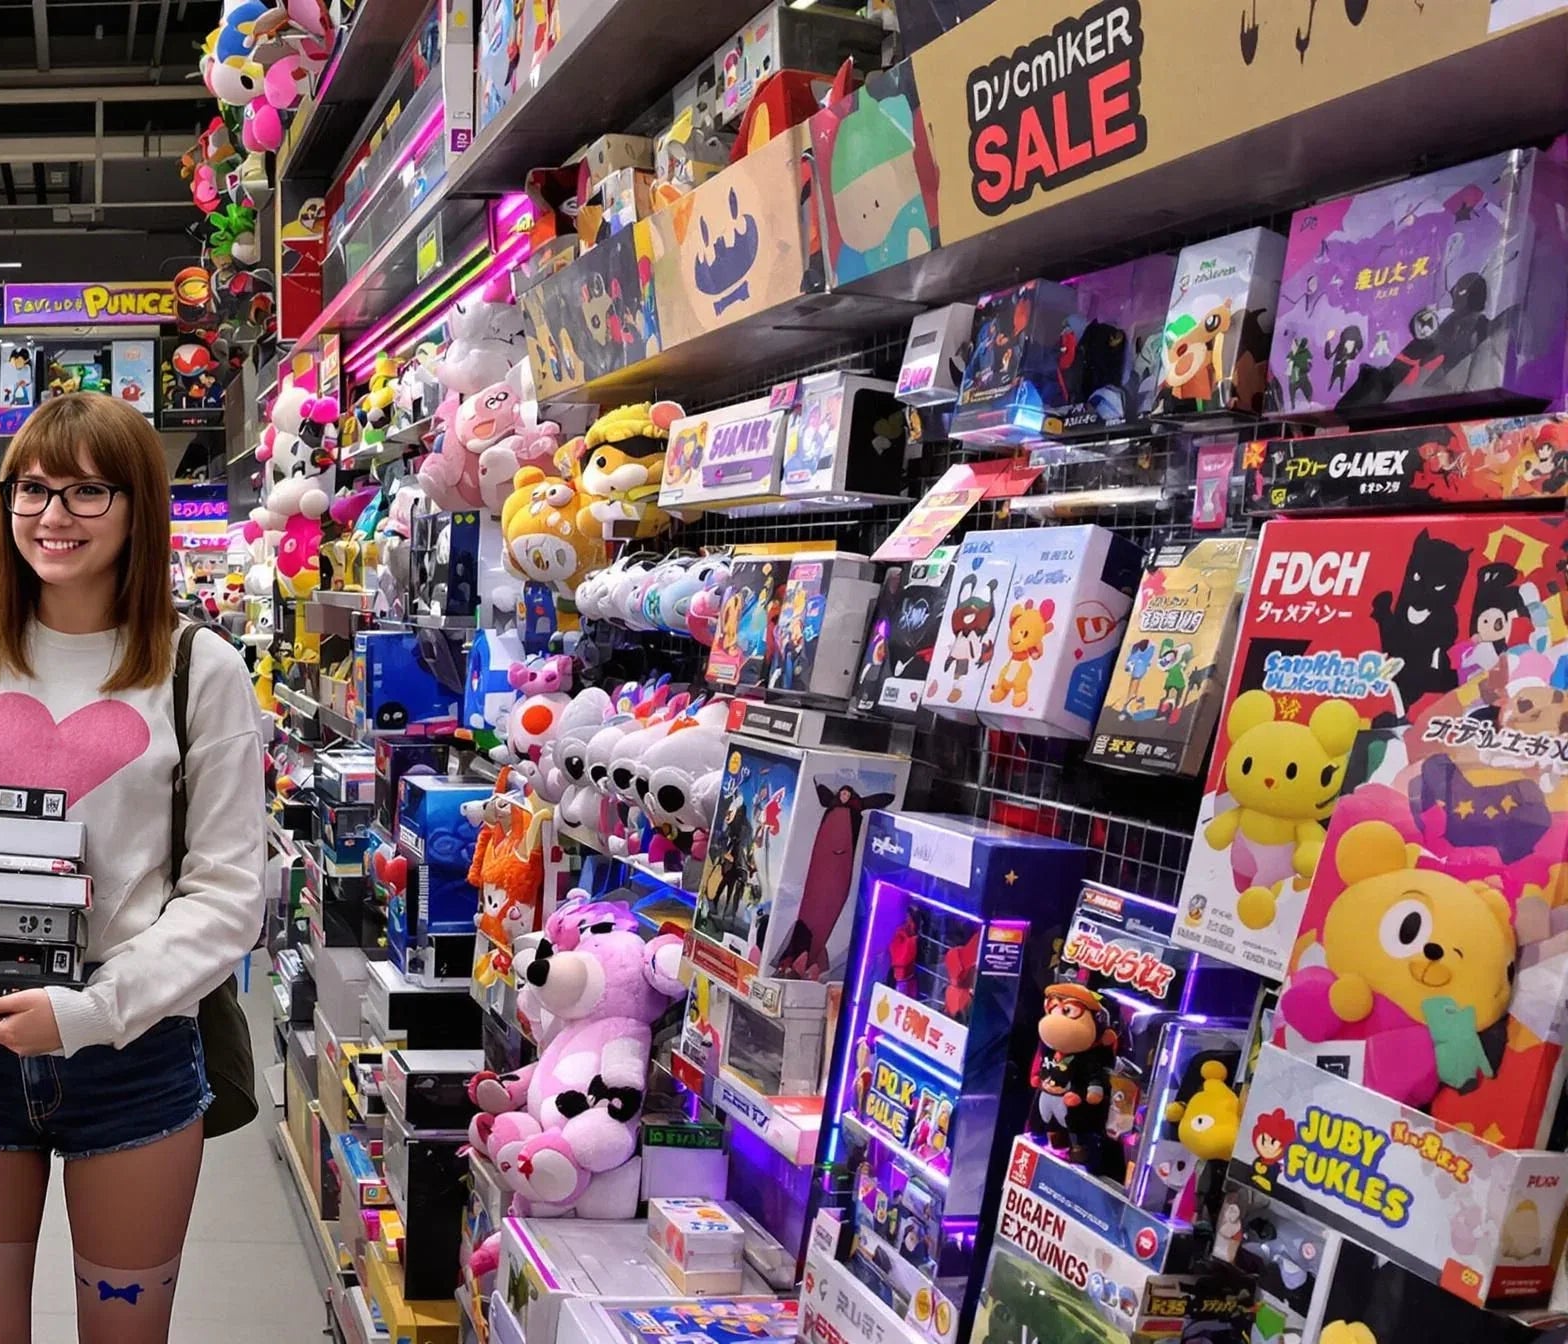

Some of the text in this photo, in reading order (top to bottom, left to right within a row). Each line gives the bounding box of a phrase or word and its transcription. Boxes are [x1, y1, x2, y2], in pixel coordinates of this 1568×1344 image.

[975, 60, 1137, 203] SALE
[83, 286, 174, 319] PUNICE
[1260, 551, 1371, 597] FDCH
[1300, 1109, 1386, 1167] JUBY
[1287, 1145, 1409, 1222] FUKLES
